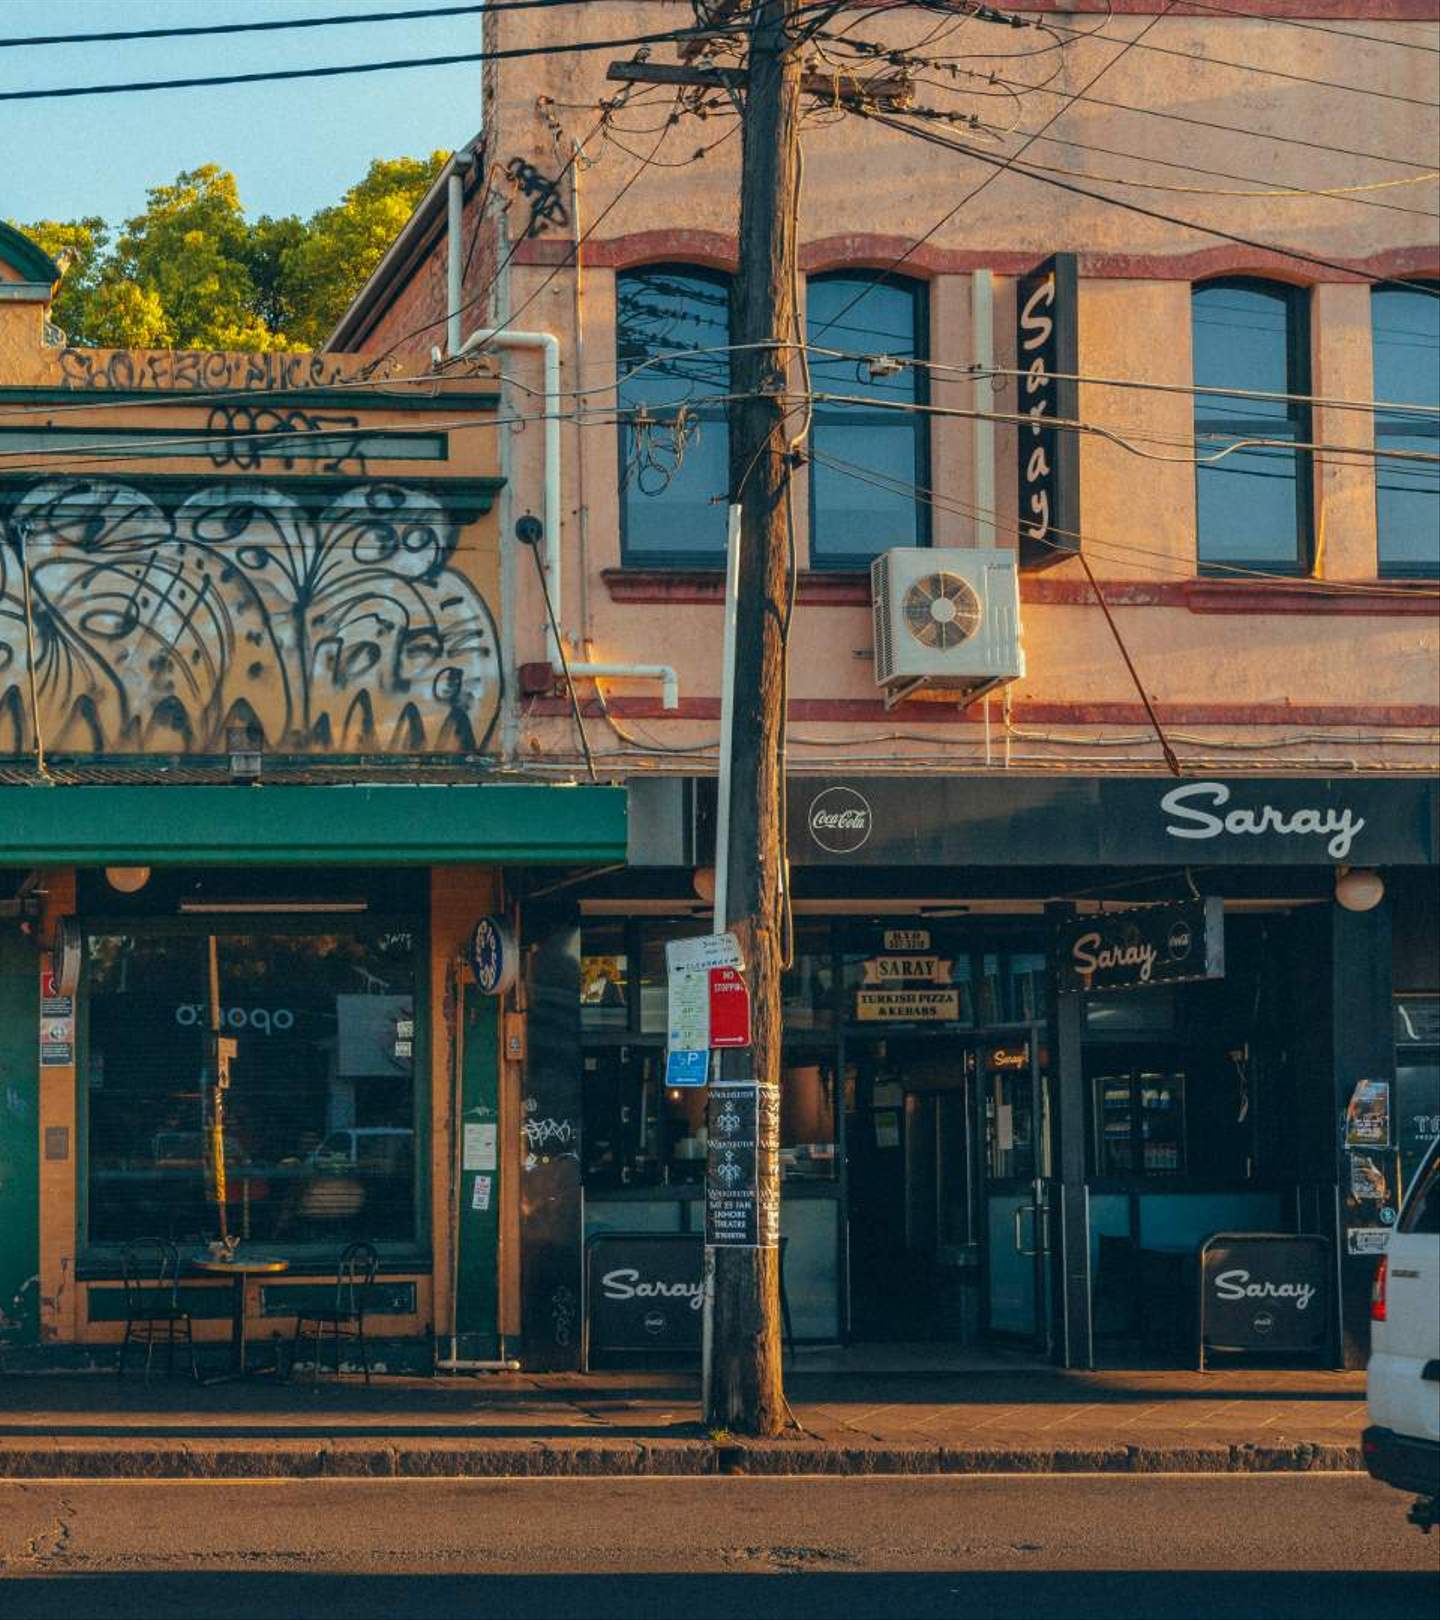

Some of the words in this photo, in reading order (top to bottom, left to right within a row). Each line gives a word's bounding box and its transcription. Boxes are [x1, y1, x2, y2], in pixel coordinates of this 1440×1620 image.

[1021, 272, 1056, 540] Saray
[1160, 782, 1364, 858] Saray
[722, 971, 735, 980] NO
[879, 960, 935, 976] SARAY
[1072, 932, 1157, 980] Saray
[861, 993, 917, 1004] TURKISH
[919, 993, 954, 1004] PIZZA
[602, 1268, 705, 1310] Saray
[1214, 1269, 1315, 1310] Saray
